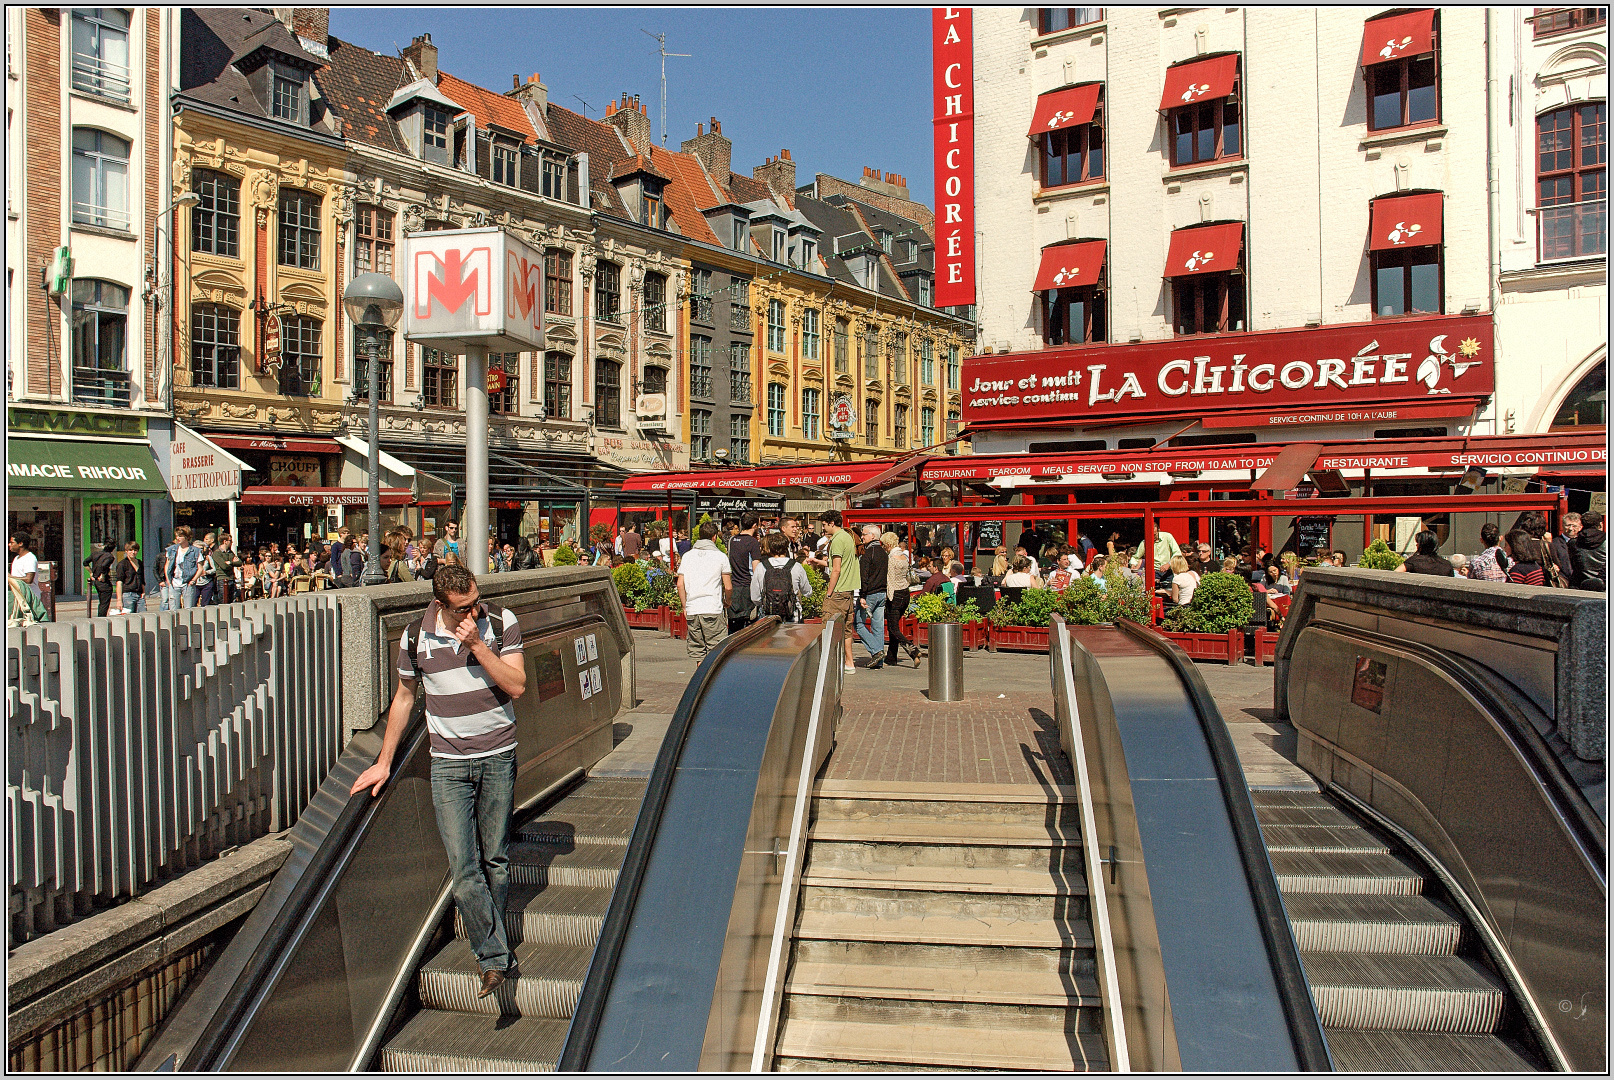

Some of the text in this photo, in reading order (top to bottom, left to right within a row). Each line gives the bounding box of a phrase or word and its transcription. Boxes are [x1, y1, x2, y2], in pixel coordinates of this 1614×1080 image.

[944, 63, 963, 284] CHICORÉE
[969, 370, 1082, 393] Jour et nuit
[1087, 363, 1147, 407] LA
[969, 389, 1079, 407] service continu
[1269, 410, 1398, 424] SERVICE CONTINU DE 10H A L'AUBE
[172, 442, 186, 455] CAFE
[182, 454, 214, 469] BRASSERIE
[1323, 456, 1409, 468] RESTAURANTE
[1451, 452, 1512, 465] SERVICIO
[1515, 450, 1588, 463] CONTINUO
[77, 465, 147, 480] RIHOUR
[923, 468, 977, 479] RESTAURANT
[988, 466, 1031, 476] TEAROOM
[1042, 464, 1073, 475] MEALS
[1077, 463, 1116, 473] SERVED
[1121, 462, 1143, 472] NON
[1145, 461, 1172, 471] STOP
[1175, 460, 1205, 470] FROM
[1208, 459, 1219, 469] 10
[1221, 459, 1238, 468] AM
[1239, 458, 1255, 468] TO
[171, 469, 239, 490] LE METROPOLE
[789, 476, 813, 484] SOLEIL
[817, 475, 828, 483] DU
[829, 474, 852, 482] NORD
